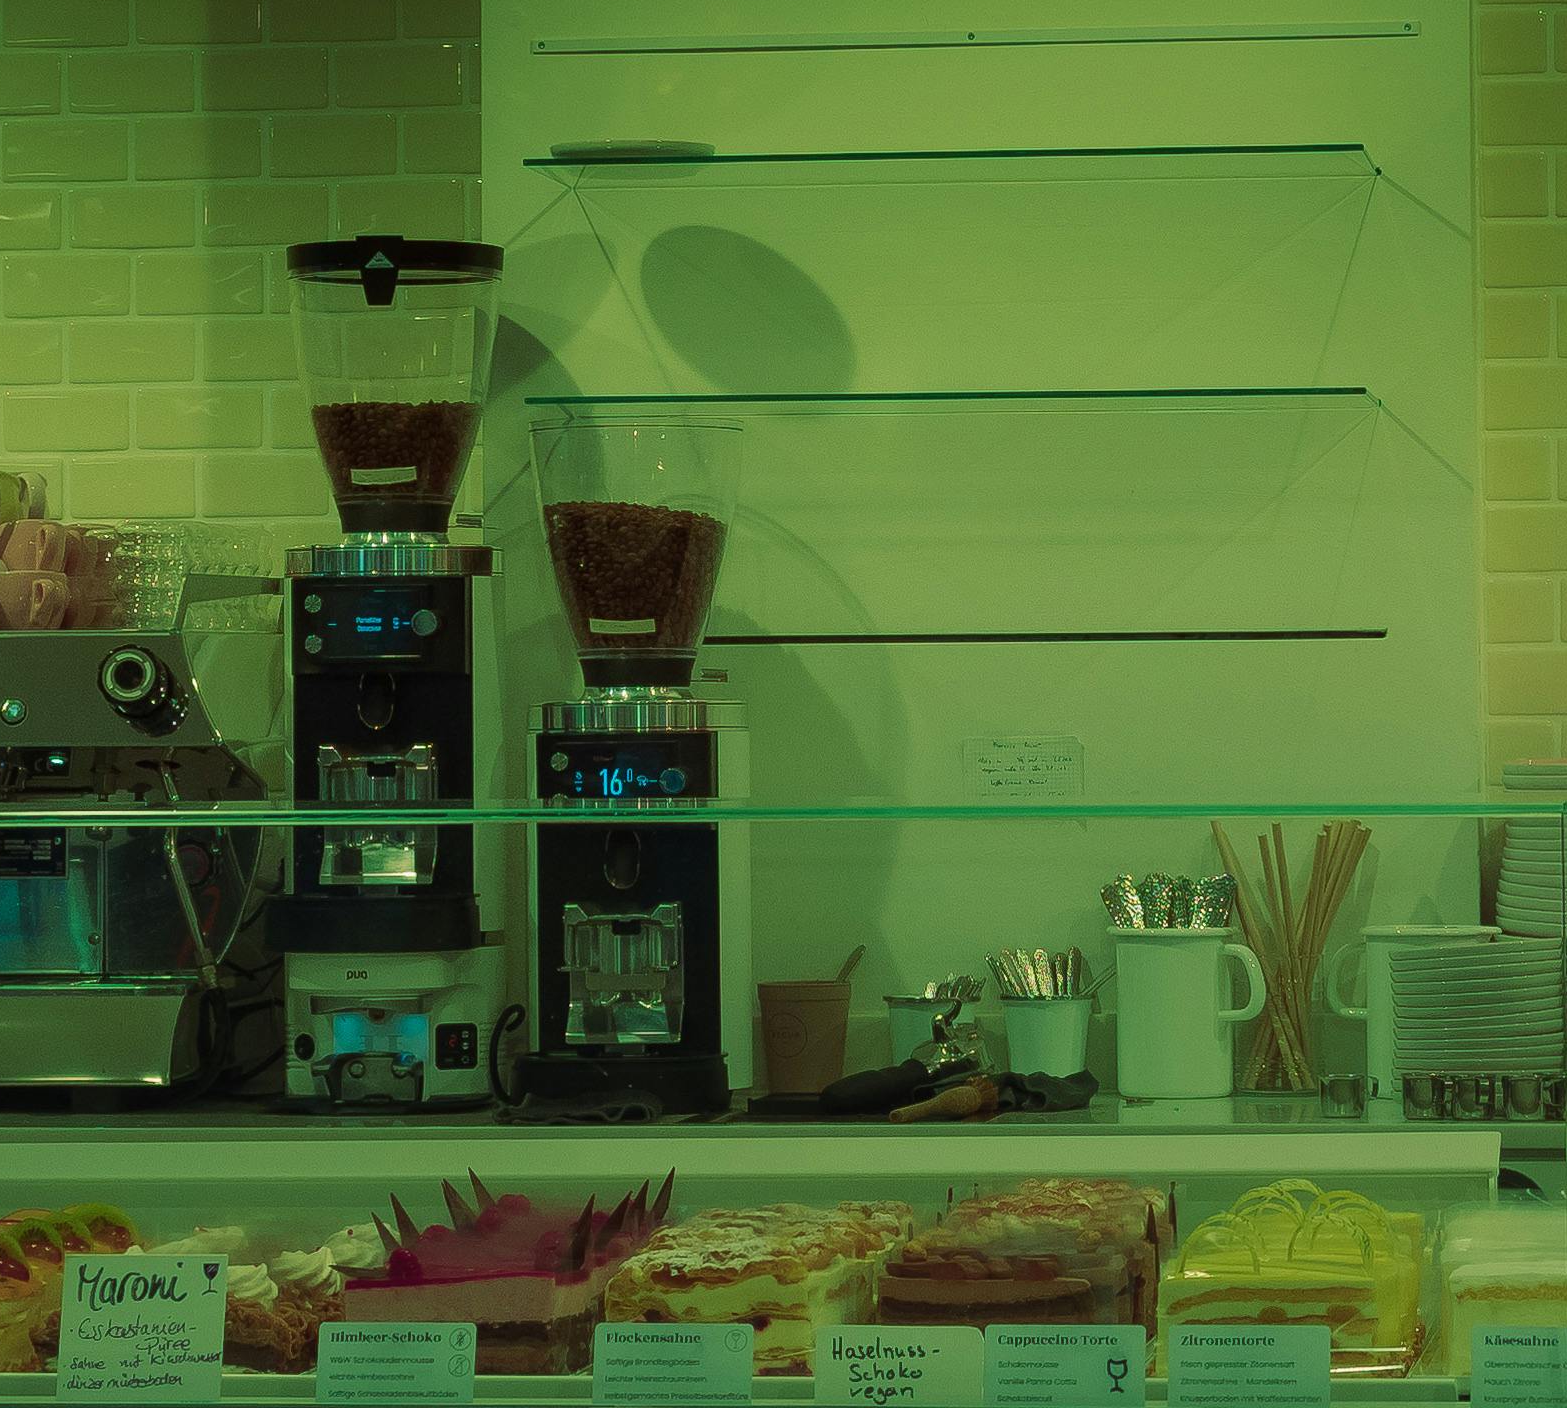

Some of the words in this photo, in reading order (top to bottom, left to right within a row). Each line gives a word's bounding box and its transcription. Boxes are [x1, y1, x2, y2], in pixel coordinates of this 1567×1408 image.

[77, 1262, 187, 1311] Maroni
[330, 1330, 442, 1343] Himbeer-Schoko
[997, 1334, 1078, 1348] Cappuccino
[1081, 1335, 1118, 1346] Torte
[1180, 1334, 1275, 1346] Zitronentorte
[1484, 1335, 1559, 1347] Käsesahne
[849, 1362, 923, 1382] Schoko
[849, 1385, 914, 1405] vegan
